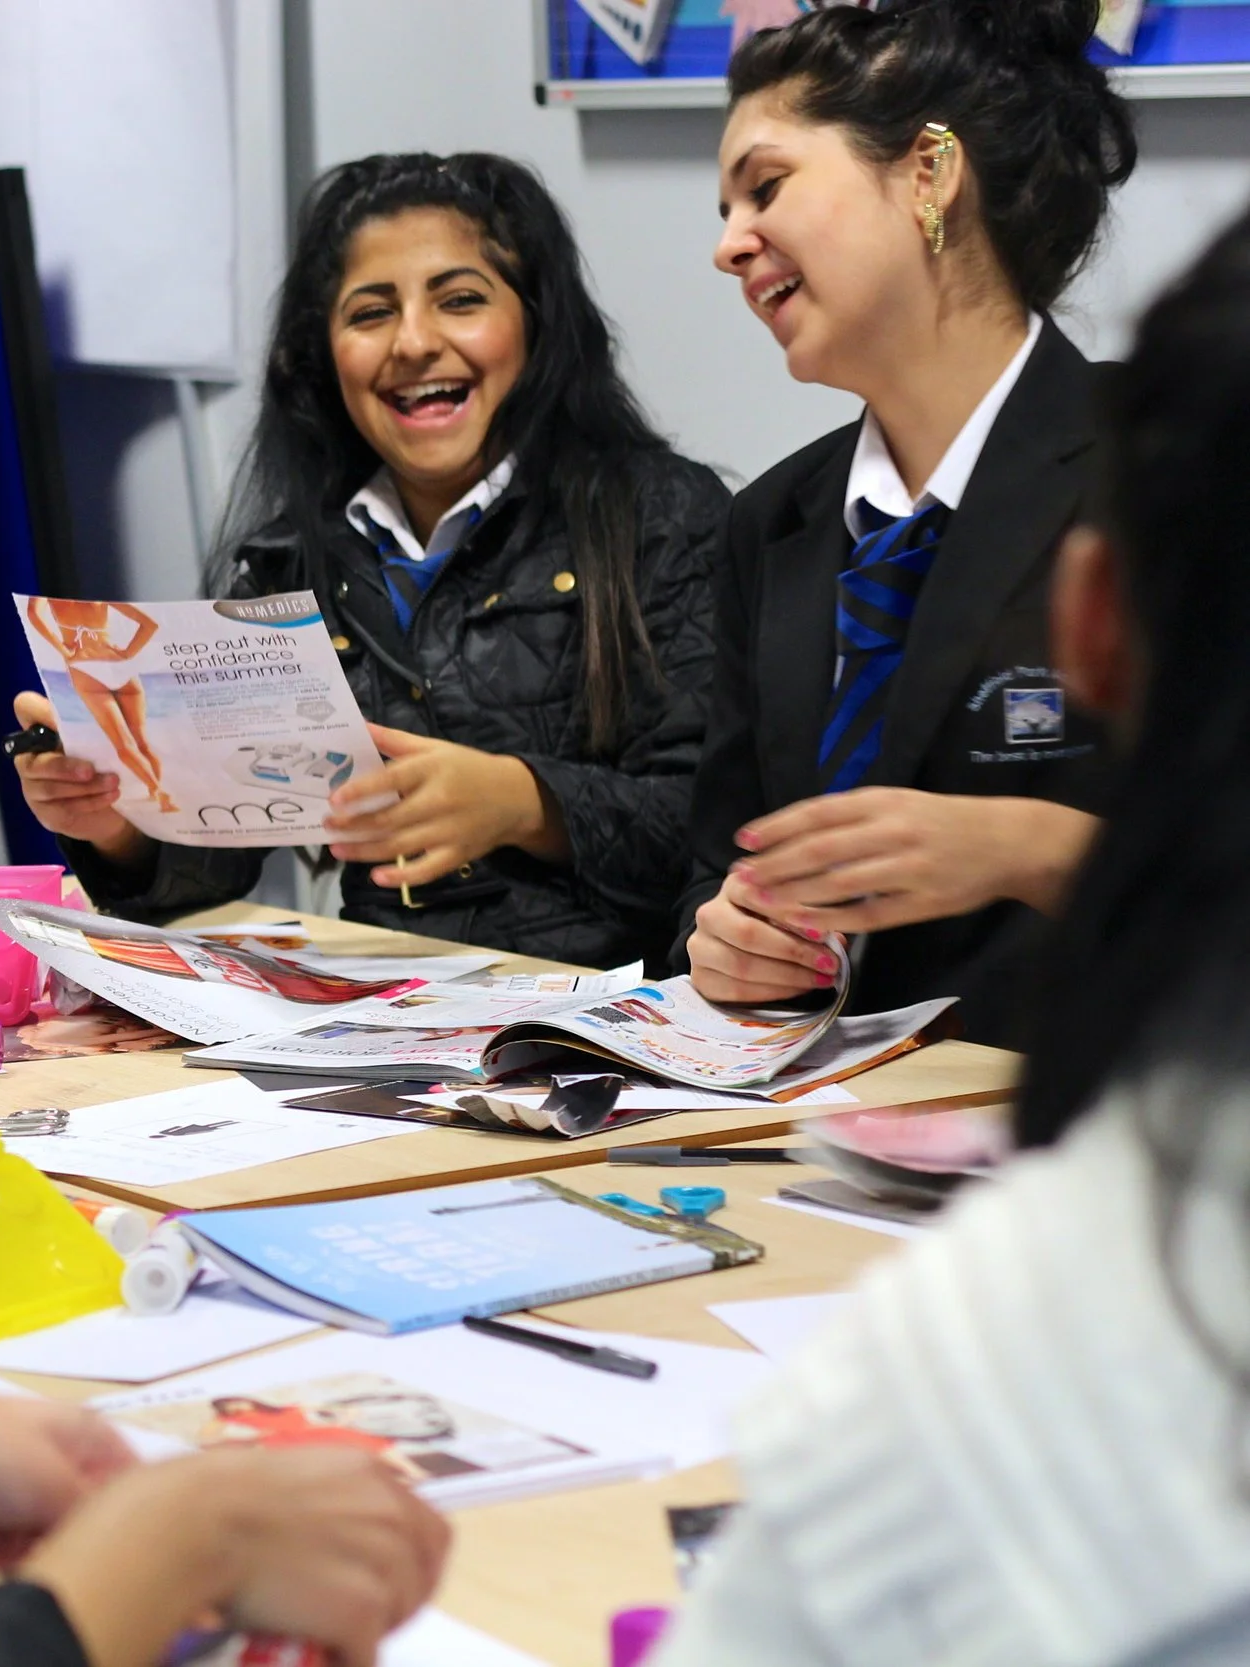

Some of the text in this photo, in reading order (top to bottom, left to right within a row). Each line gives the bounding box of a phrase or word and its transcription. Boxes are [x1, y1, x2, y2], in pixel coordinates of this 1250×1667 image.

[163, 633, 297, 657] step out with
[169, 649, 294, 671] confidence
[173, 663, 303, 685] this summer
[102, 985, 207, 1036] No calories
